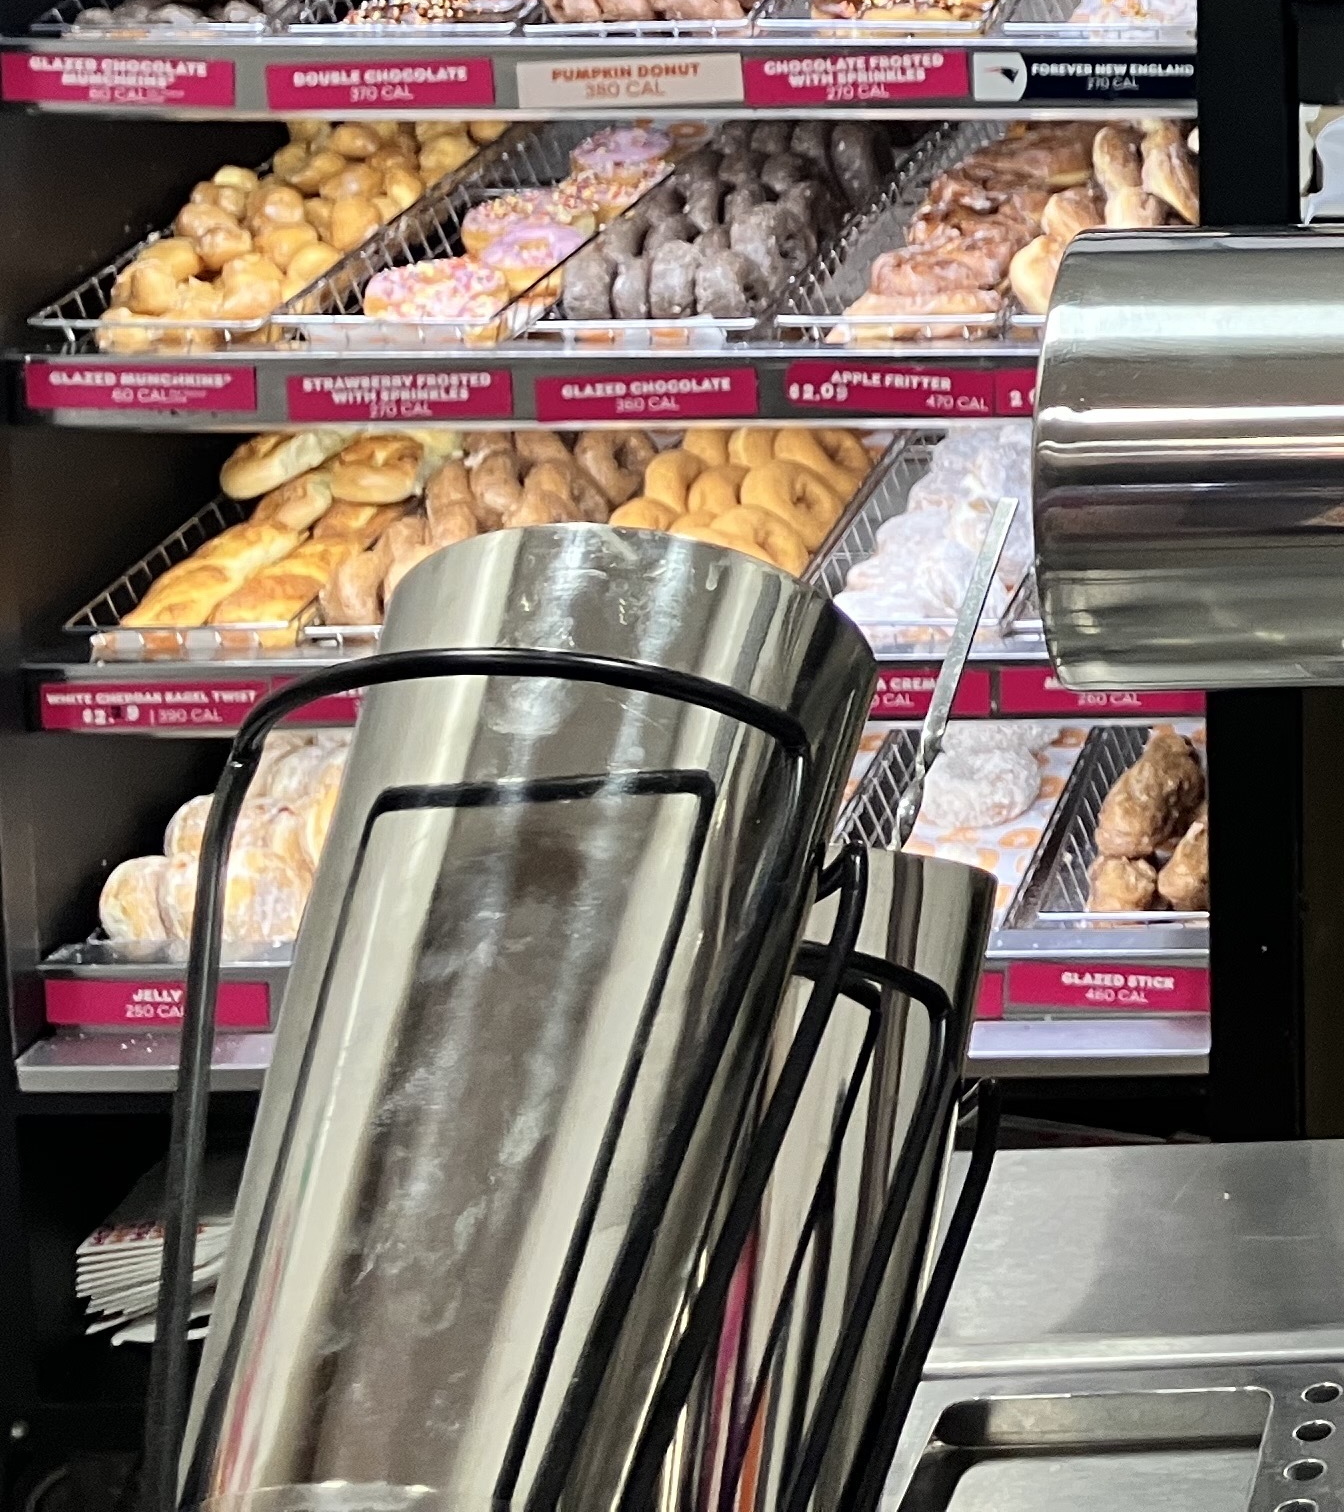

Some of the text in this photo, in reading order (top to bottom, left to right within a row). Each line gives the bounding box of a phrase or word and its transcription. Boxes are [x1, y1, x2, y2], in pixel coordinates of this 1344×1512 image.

[29, 56, 208, 78] GLAZED CHOCOLATE
[552, 62, 700, 83] PUMPKIN DONUT
[764, 53, 944, 76] CHOCOLATE FROSTED
[1031, 63, 1194, 78] FOREVER NEW ENGLAND
[293, 65, 468, 88] DOUBLE CHOCOLATE
[788, 67, 926, 88] WITH SPRINKLES
[1112, 76, 1139, 91] CAL
[380, 84, 414, 101] CAL
[626, 79, 665, 98] CAL
[858, 84, 889, 99] CAL
[49, 371, 117, 387] GLAZED
[302, 372, 491, 393] STRAWBERRY FROSTED
[830, 370, 951, 392] APPLE FRITTER
[137, 388, 168, 403] CAL
[331, 387, 469, 405] WITH SPRINKLES
[561, 376, 732, 400] GLAZED CHOCOLATE
[400, 402, 433, 418] CAL
[649, 396, 680, 412] CAL
[956, 394, 989, 412] CAL
[211, 690, 256, 704] TWIST
[882, 692, 915, 708] CAL
[1109, 692, 1142, 706] CAL
[191, 707, 223, 723] CAL
[1062, 972, 1175, 989] GLAZED STICK
[132, 988, 182, 1004] JELLY
[1118, 989, 1148, 1004] CAL
